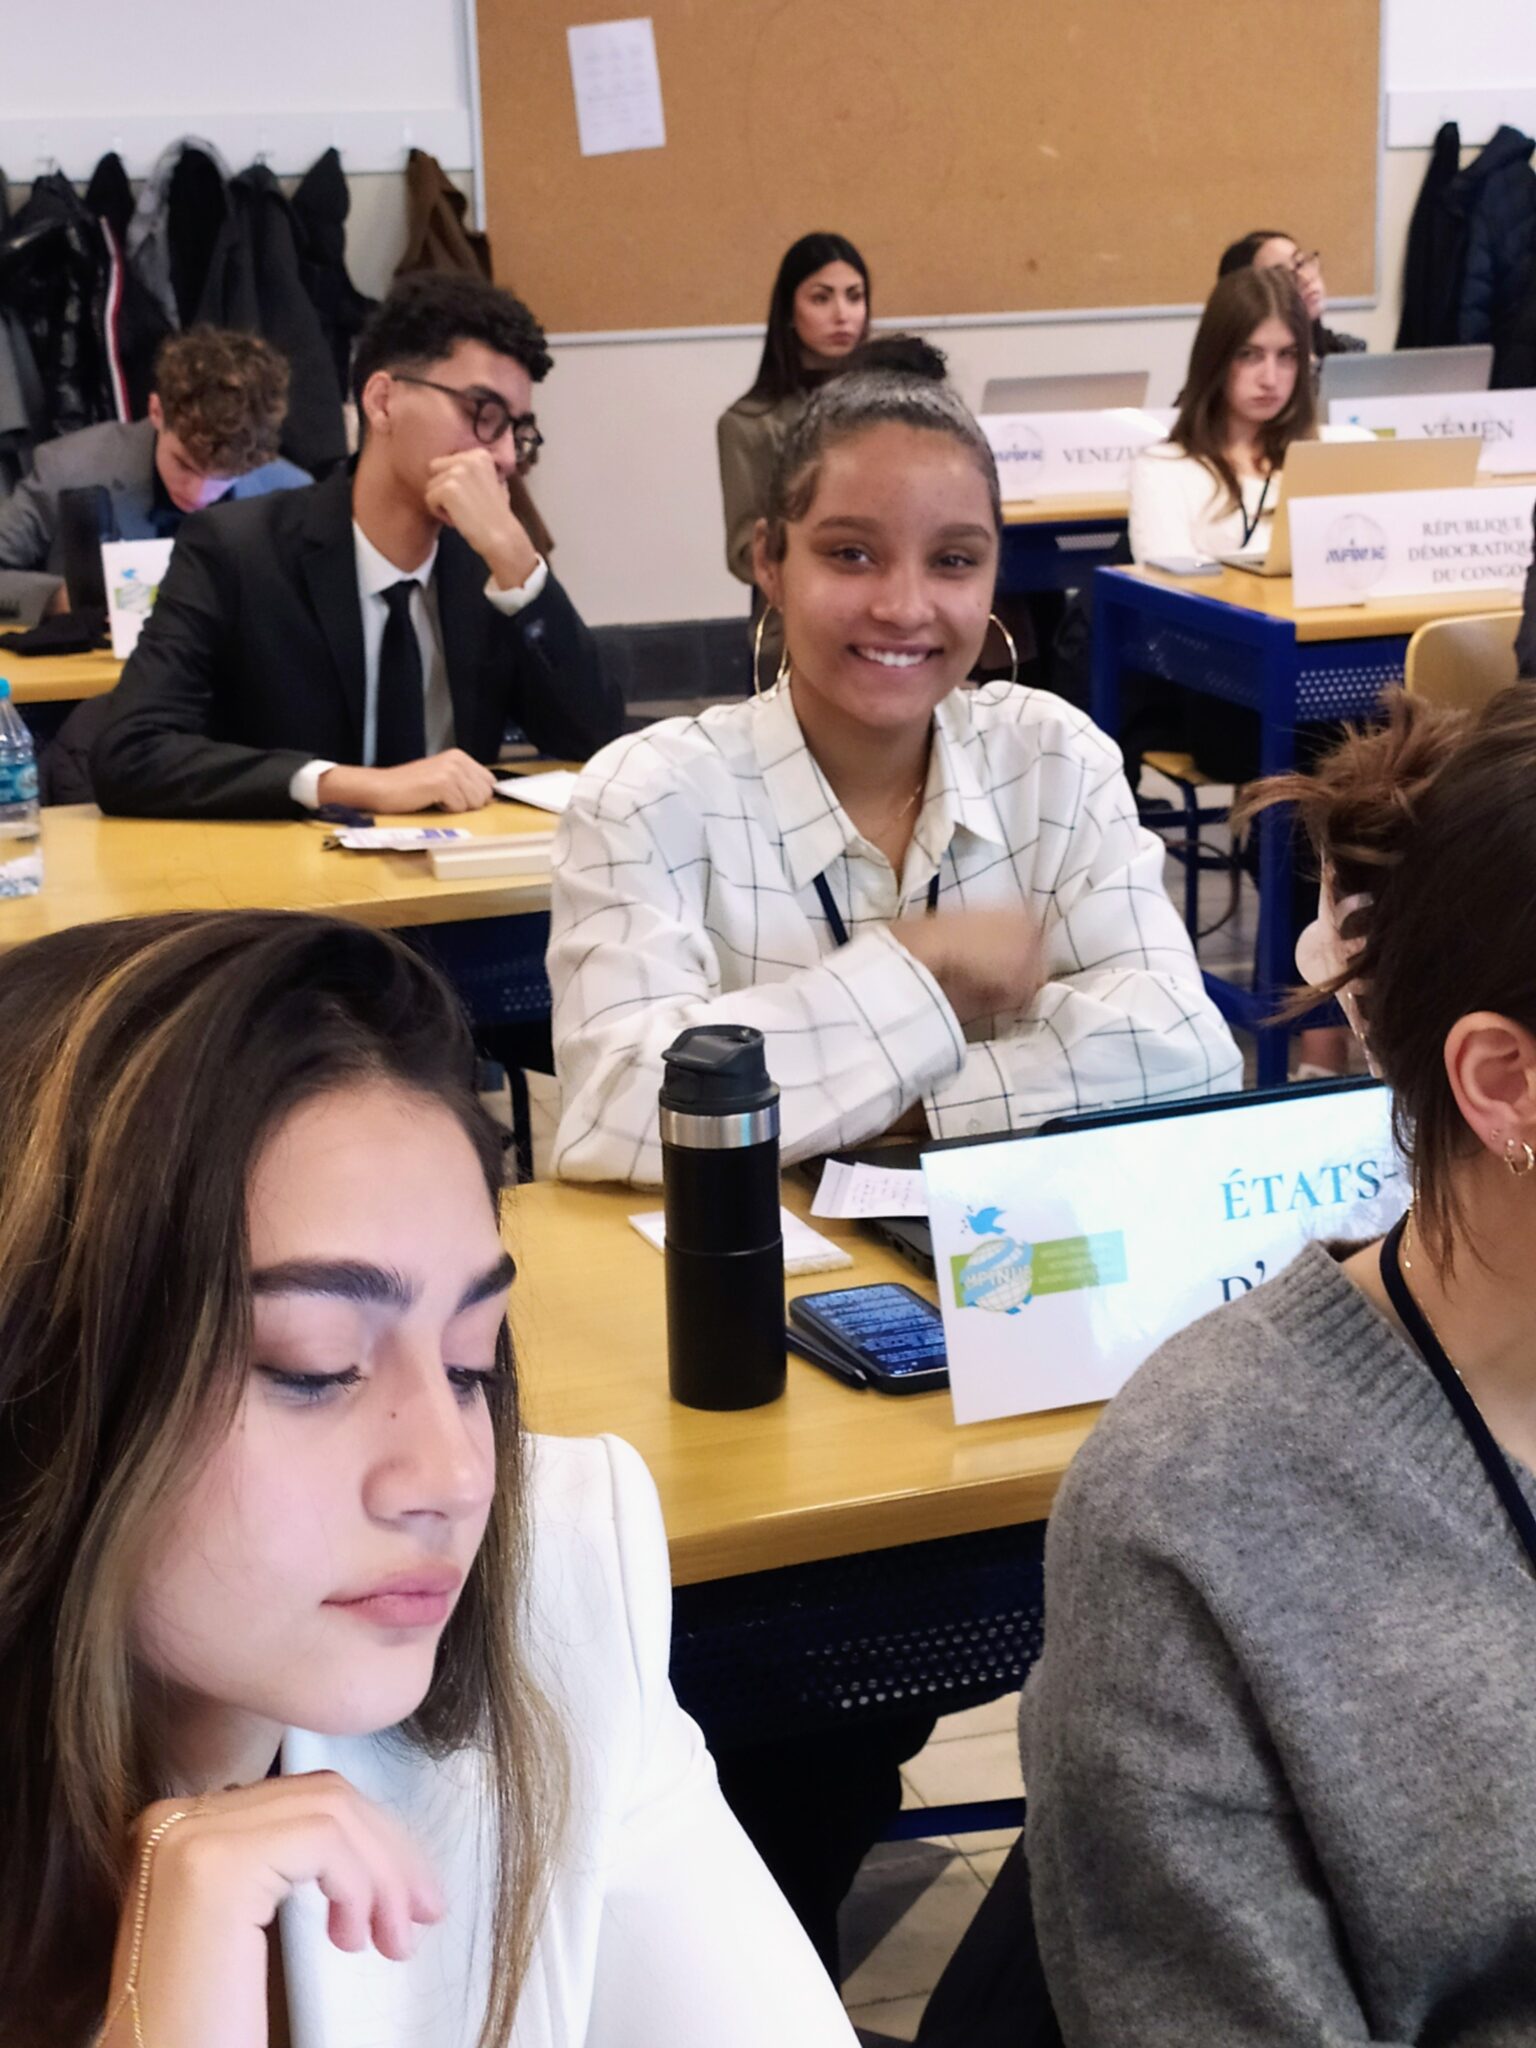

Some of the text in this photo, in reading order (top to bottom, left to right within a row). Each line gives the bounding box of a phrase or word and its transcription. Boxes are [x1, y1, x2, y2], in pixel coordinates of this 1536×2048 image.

[1422, 516, 1523, 536] RÉPUBLIQUE
[1408, 540, 1532, 561] DÉMOCRATIQU
[1432, 568, 1456, 583] DU
[1219, 1159, 1399, 1221] ÉTATS-
